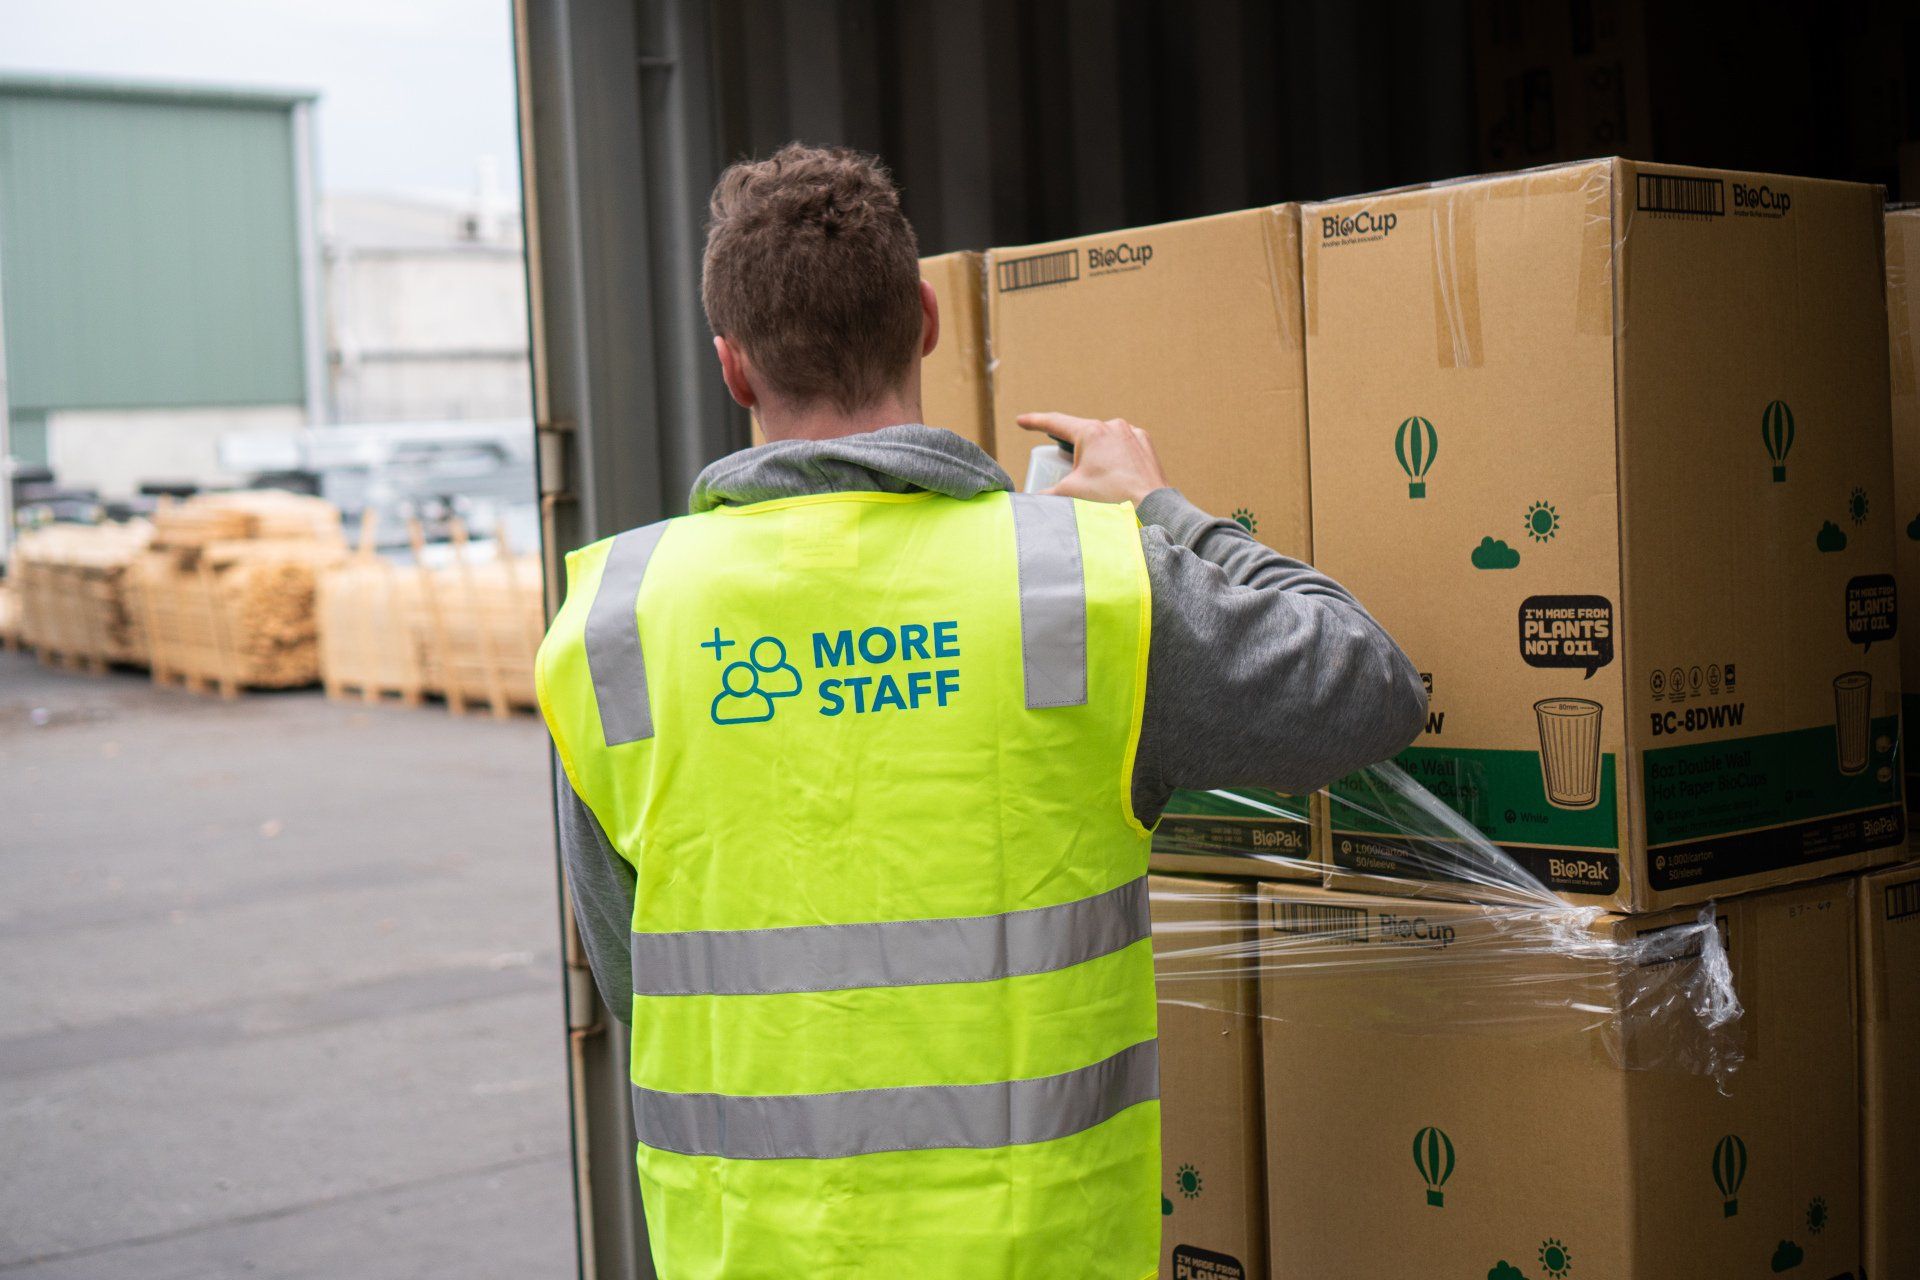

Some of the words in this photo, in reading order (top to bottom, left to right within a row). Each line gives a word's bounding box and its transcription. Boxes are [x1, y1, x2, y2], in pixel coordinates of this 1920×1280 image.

[1732, 183, 1791, 216] BioCup
[1322, 211, 1397, 239] BioCup
[1088, 243, 1153, 269] BioCup
[1525, 608, 1544, 619] I'M
[1546, 608, 1575, 619] MADE
[1577, 608, 1609, 619] FROM
[1849, 596, 1895, 617] PLANTS
[1524, 620, 1609, 638] PLANTS
[1849, 616, 1870, 632] NOT
[1871, 615, 1890, 630] OIL
[812, 621, 960, 668] MORE
[1525, 640, 1559, 655] NOT
[1563, 640, 1599, 655] OIL
[819, 669, 960, 716] STAFF
[1650, 703, 1744, 736] BC-8DWW
[1679, 755, 1722, 776] Double
[1726, 751, 1751, 768] Wall
[1652, 784, 1677, 802] Hot
[1680, 779, 1715, 800] Paper
[1863, 815, 1898, 837] BioPak
[1252, 829, 1302, 848] BioPak
[1548, 858, 1609, 880] BioPak
[1379, 913, 1456, 948] BioCup
